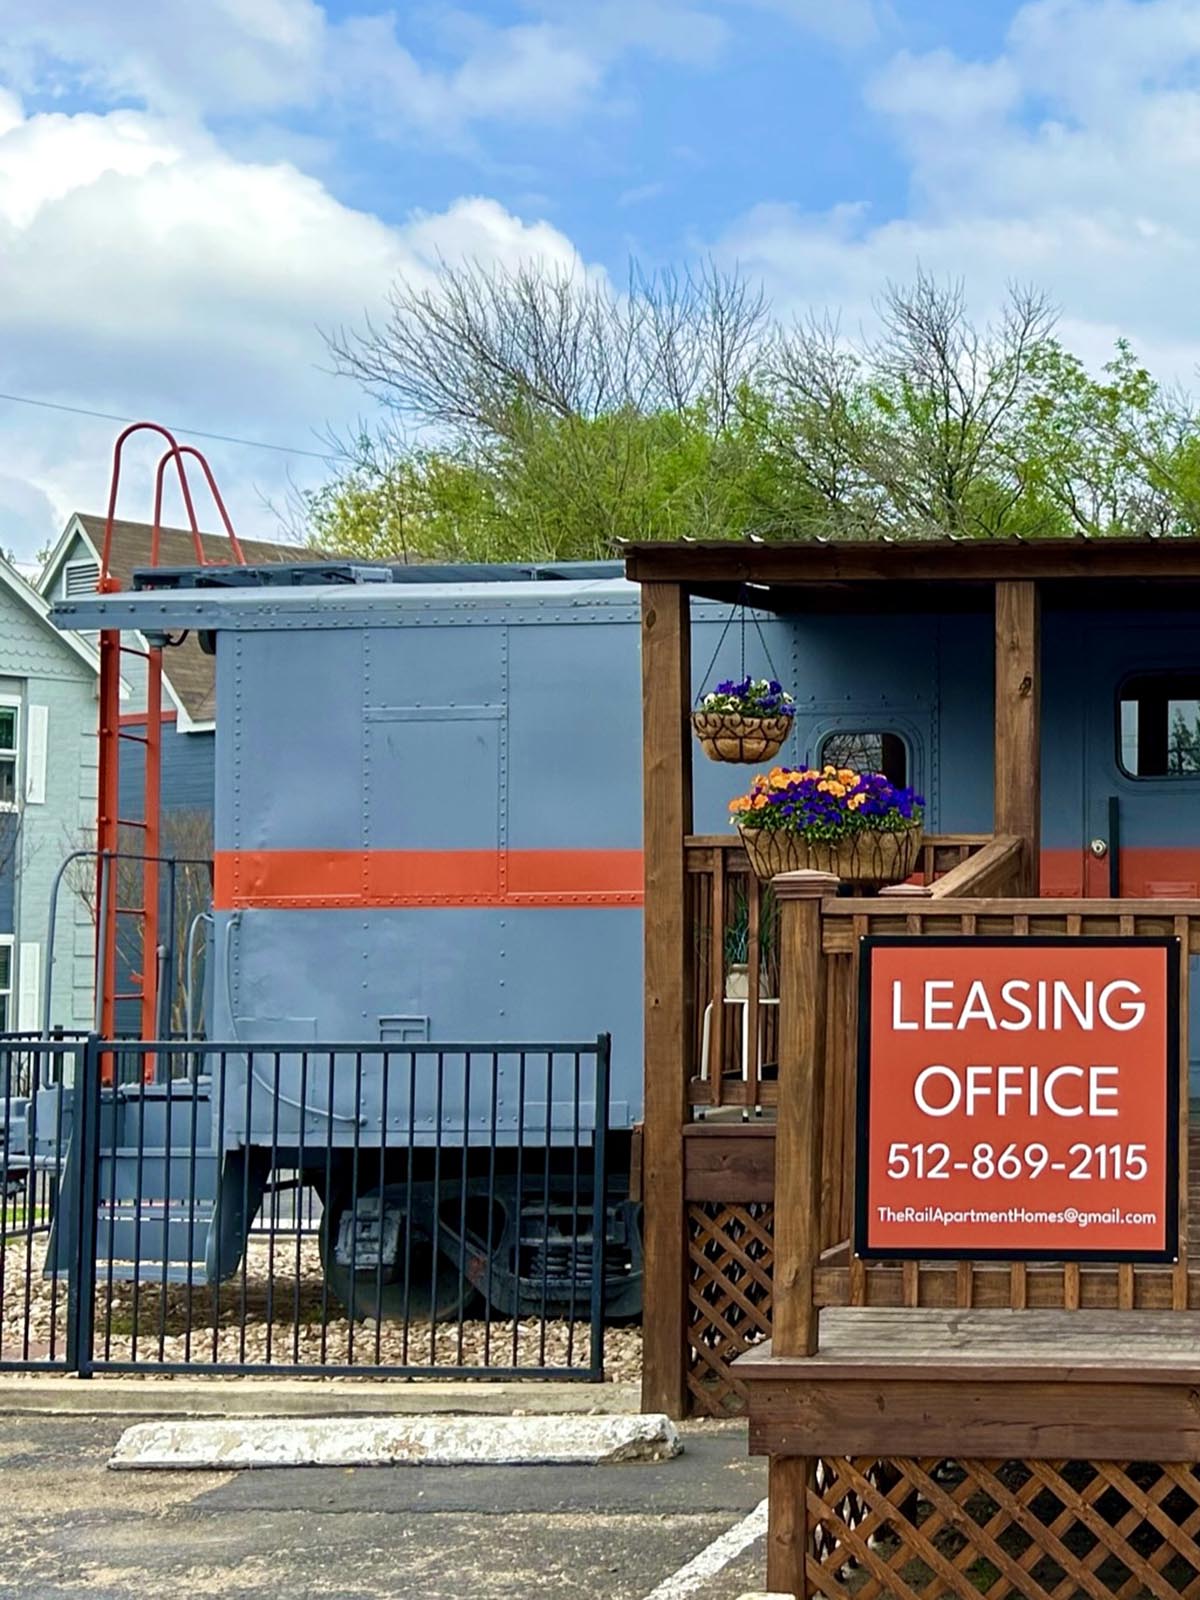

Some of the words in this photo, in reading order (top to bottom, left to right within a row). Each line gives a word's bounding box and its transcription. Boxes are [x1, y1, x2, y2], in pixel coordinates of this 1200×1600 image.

[892, 979, 1147, 1032] LEASING
[914, 1065, 1119, 1117] OFFICE
[887, 1142, 1148, 1181] 512-869-2115
[877, 1206, 1157, 1227] TheRailApartmentHomes@gmail.com
